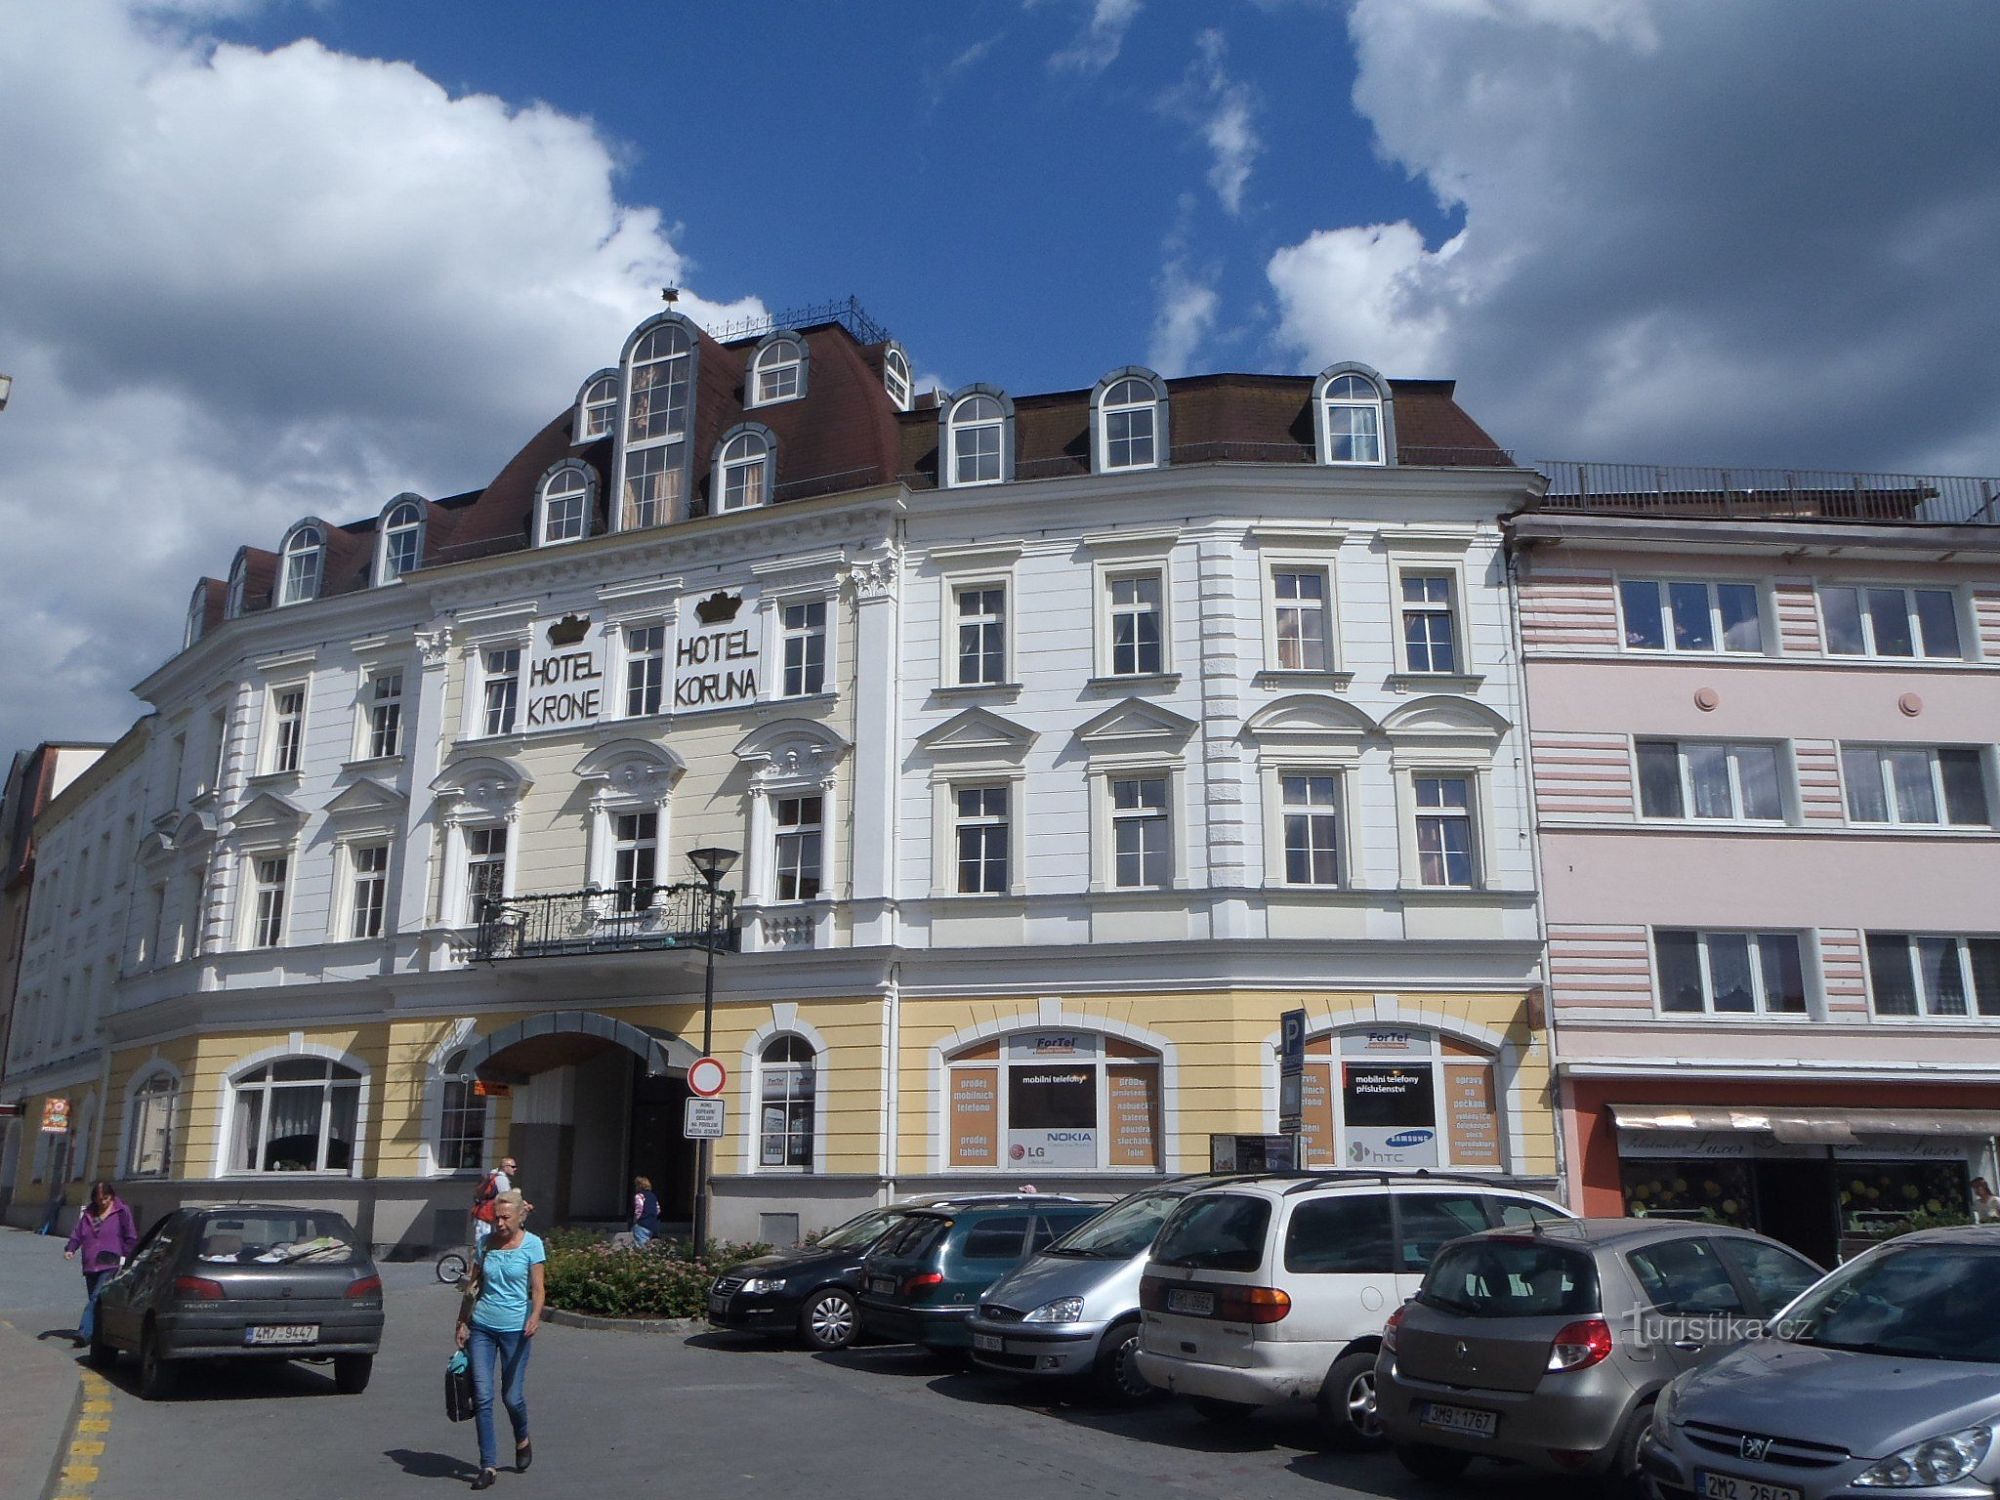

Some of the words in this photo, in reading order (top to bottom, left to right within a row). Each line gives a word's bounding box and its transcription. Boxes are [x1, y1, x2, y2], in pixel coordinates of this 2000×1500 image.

[676, 629, 759, 667] HOTEL
[530, 652, 602, 688] HOTEL
[674, 668, 757, 707] KORUNA
[527, 689, 600, 726] KRONE
[1286, 1019, 1299, 1053] P
[1386, 1074, 1419, 1085] telefony
[1047, 1132, 1092, 1141] NOKIA
[1028, 1146, 1045, 1157] LG
[255, 1327, 276, 1339] 4M7
[285, 1326, 313, 1339] 9447
[1431, 1404, 1453, 1425] 3M9
[1462, 1410, 1491, 1430] 1767
[1708, 1476, 1737, 1500] 2M2
